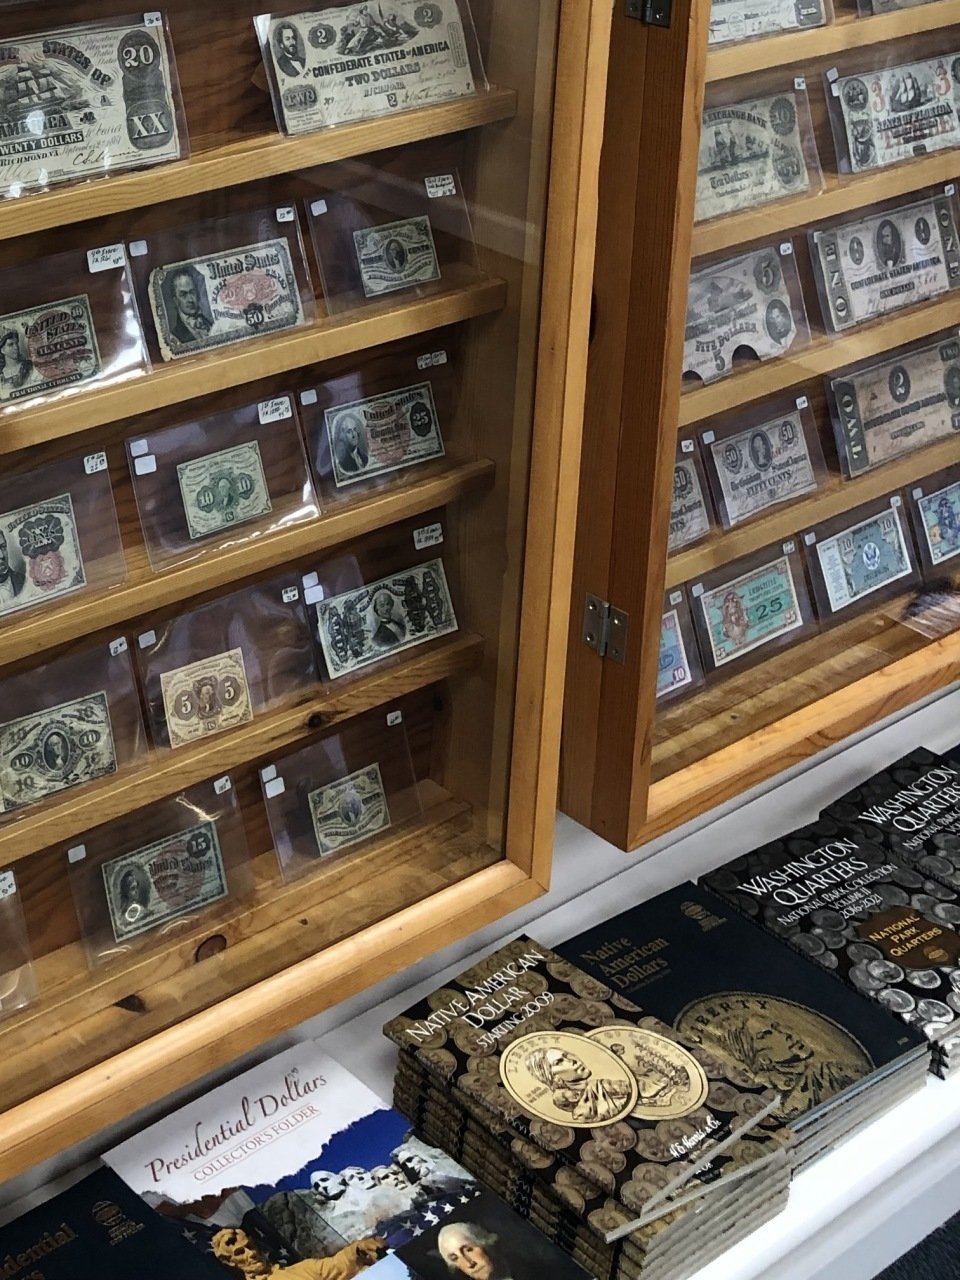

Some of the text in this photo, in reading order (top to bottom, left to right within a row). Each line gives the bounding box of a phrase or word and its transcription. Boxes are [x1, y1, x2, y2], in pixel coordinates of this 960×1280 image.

[423, 8, 434, 23] 2
[317, 28, 328, 44] 2
[43, 40, 91, 71] STATES
[122, 46, 154, 68] 20
[312, 40, 450, 78] CONFEDERATE STATES AMERICA
[345, 73, 371, 87] TWO
[871, 80, 886, 114] 3
[133, 112, 169, 139] XX
[40, 131, 83, 148] DOLLARS
[207, 253, 281, 281] United States
[760, 260, 775, 287] 5
[247, 312, 264, 325] 50
[713, 349, 726, 372] 5
[893, 372, 905, 395] 2
[413, 412, 430, 427] 25
[782, 425, 793, 441] 50
[725, 449, 738, 465] 50
[239, 475, 253, 493] 10
[198, 492, 214, 510] 10
[755, 596, 783, 621] 25
[674, 668, 685, 682] 10
[224, 680, 236, 701] 5
[180, 695, 192, 714] 5
[84, 733, 98, 745] 10
[14, 756, 30, 769] 10
[858, 764, 959, 825] WASHINGTON
[191, 835, 208, 852] 15
[737, 837, 860, 897] WASHINGTON
[773, 856, 870, 907] QUARTERS
[777, 862, 899, 927] NATIONAL PARK COLLECTION
[828, 889, 862, 912] VOLUME
[839, 893, 884, 921] 2016-2021
[869, 914, 921, 942] NATIONAL
[890, 926, 920, 944] PARK
[580, 935, 633, 965] Native
[889, 926, 943, 958] QUARTERS
[598, 936, 671, 977] American
[609, 956, 670, 990] Dollars
[406, 948, 546, 1043] NATIVE AMERICAN
[461, 984, 530, 1029] DOLLAR
[476, 990, 556, 1049] STARTING 2009
[692, 998, 768, 1047] LIBERTY
[507, 1035, 562, 1074] LIBERTY
[144, 1073, 328, 1184] Presidential Dollars
[193, 1102, 321, 1183] COLLECTOR'S FOLDER
